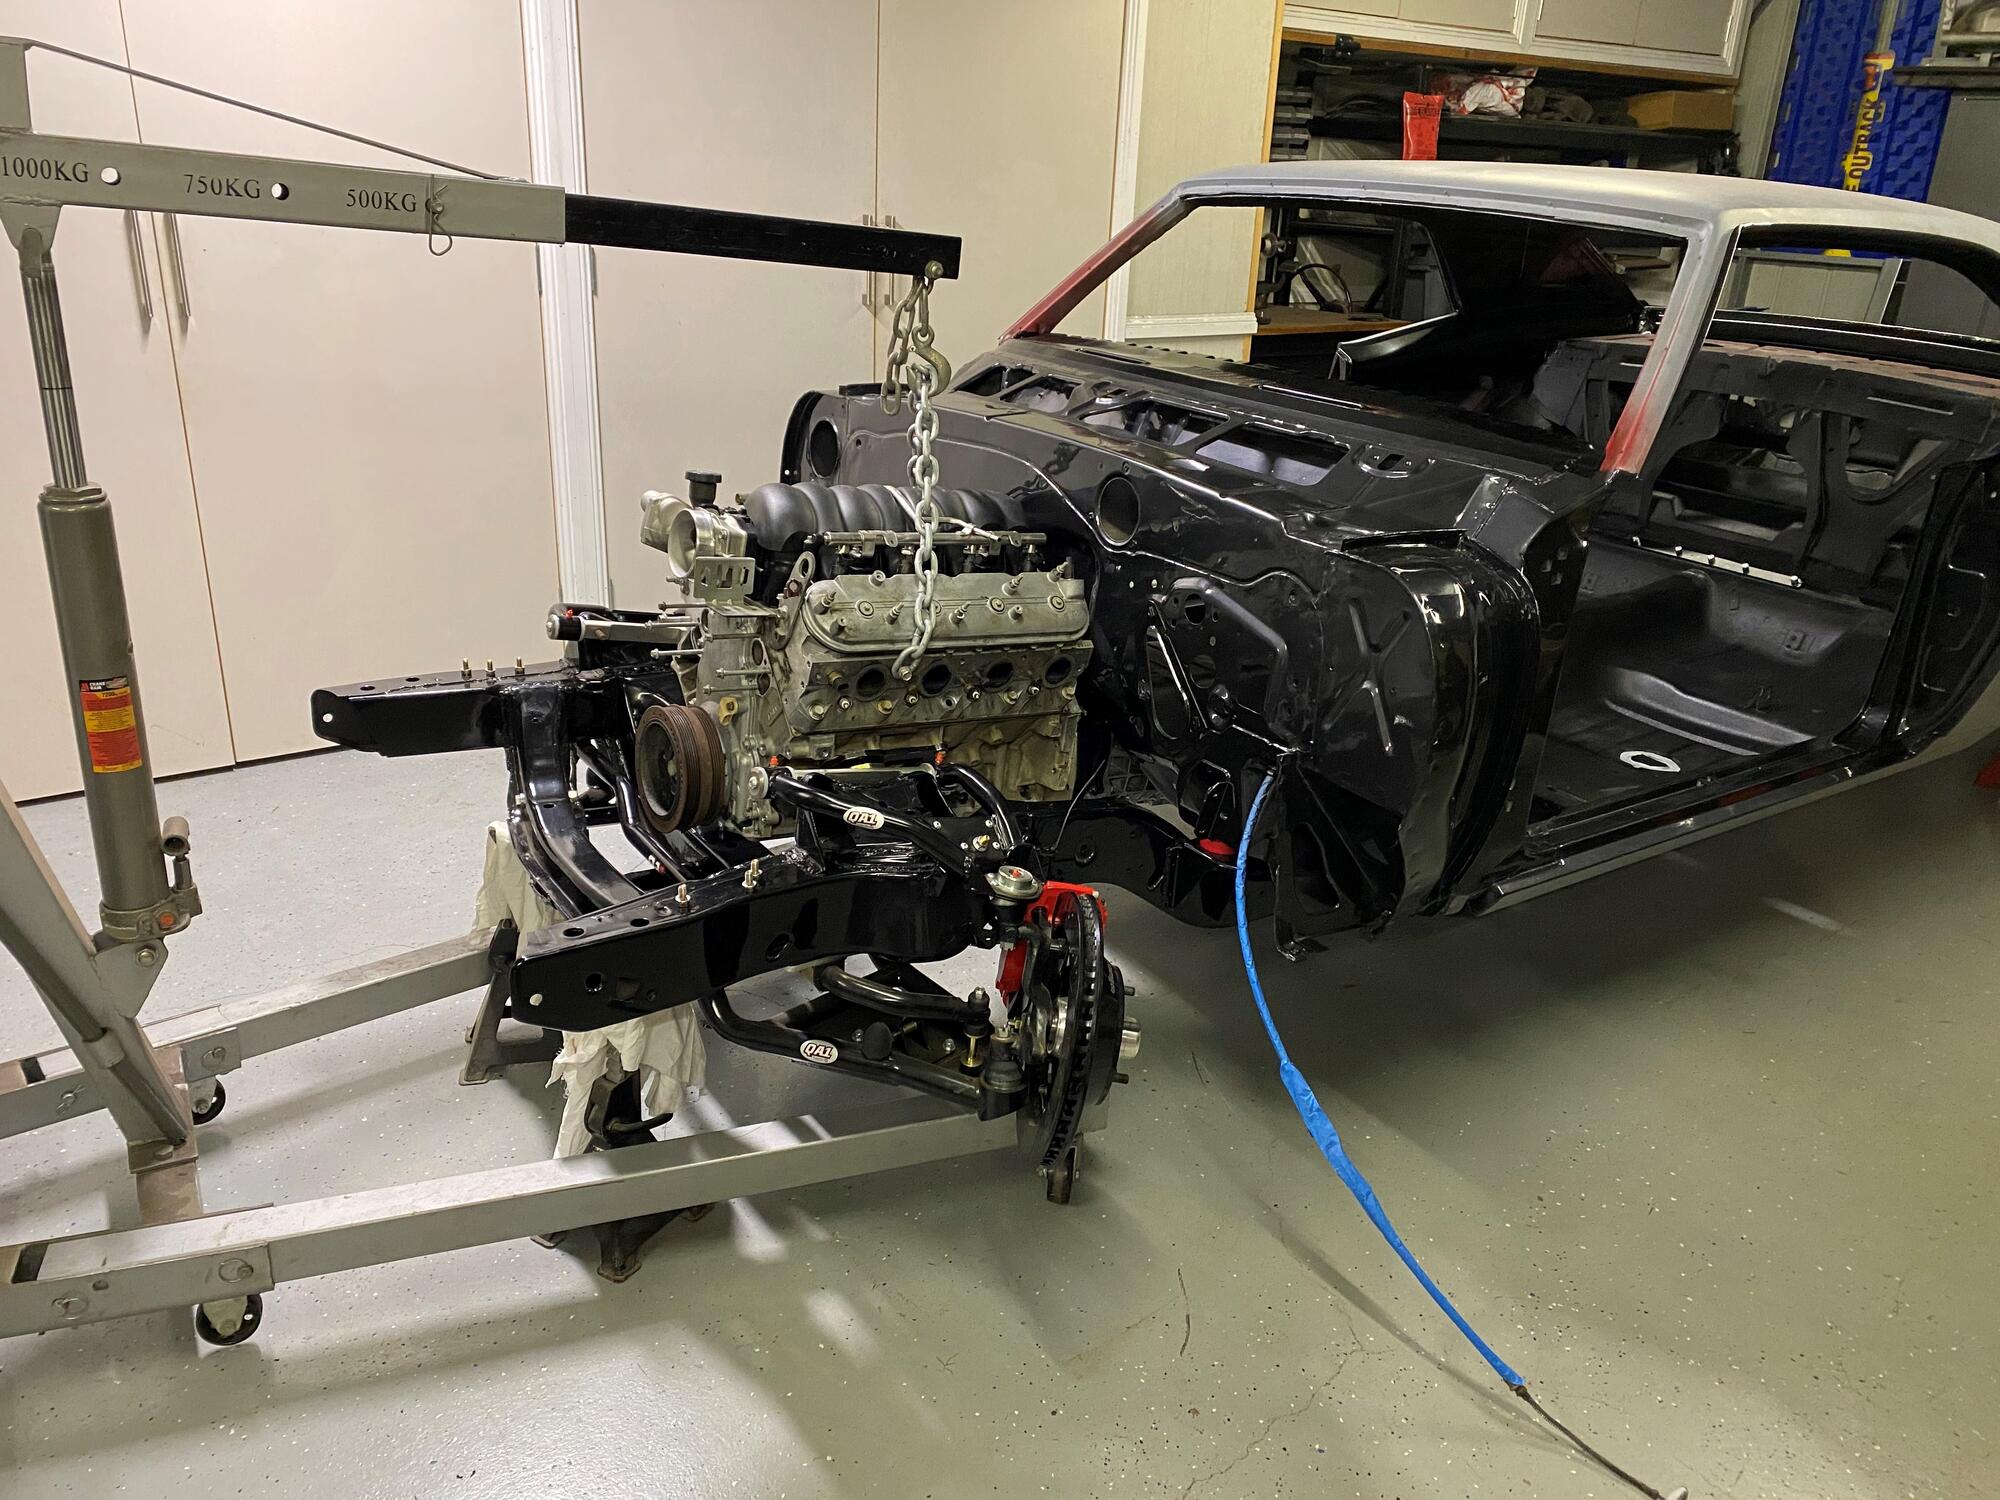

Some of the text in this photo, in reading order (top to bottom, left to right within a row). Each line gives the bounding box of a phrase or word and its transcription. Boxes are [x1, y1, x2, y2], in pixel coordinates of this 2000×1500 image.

[2, 156, 88, 182] 1000KG
[183, 174, 260, 198] 750KG
[346, 189, 416, 212] 500KG
[847, 811, 878, 825] QA1
[804, 1043, 834, 1059] QA1
